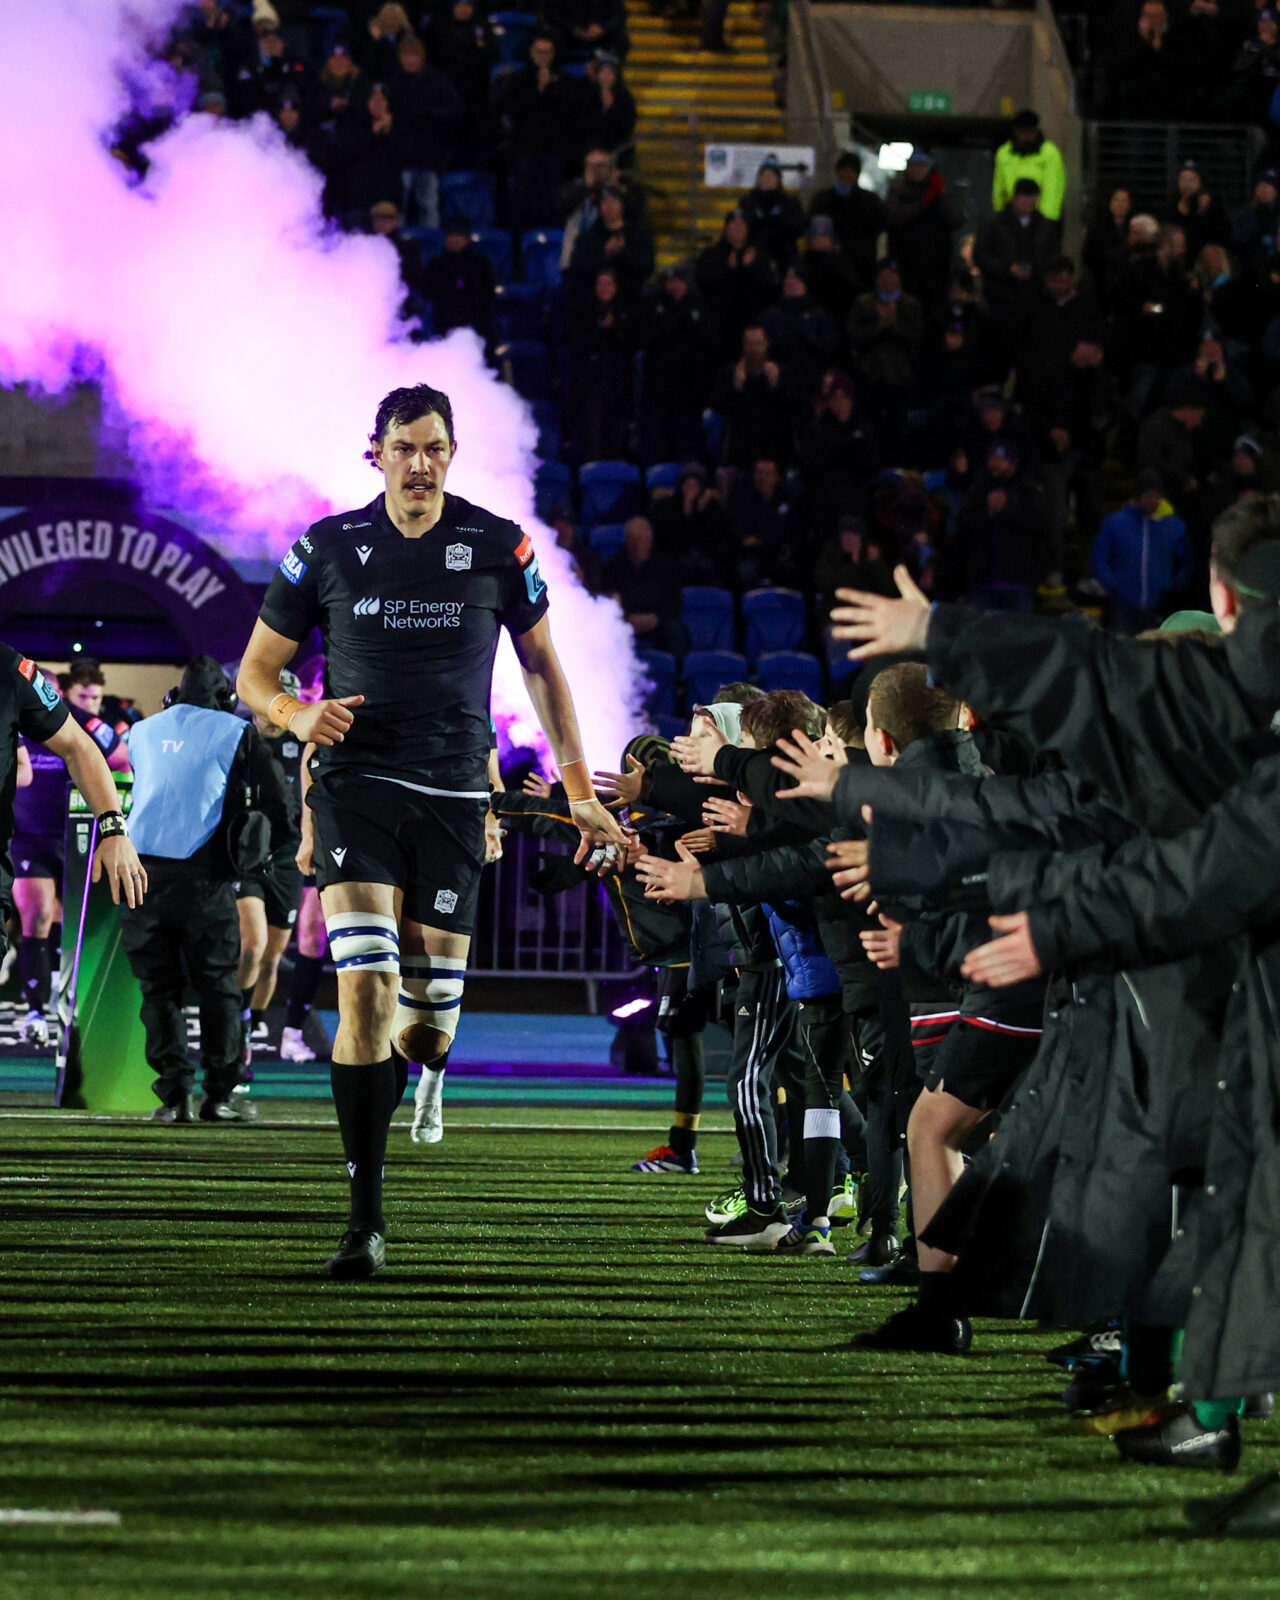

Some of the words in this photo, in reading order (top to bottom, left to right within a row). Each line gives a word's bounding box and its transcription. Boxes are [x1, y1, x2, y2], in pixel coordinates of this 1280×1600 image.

[117, 524, 158, 571] TO
[150, 542, 227, 610] PLAY
[383, 600, 407, 614] SP
[409, 599, 465, 615] Energy
[383, 615, 461, 629] Networks
[161, 739, 185, 753] TV
